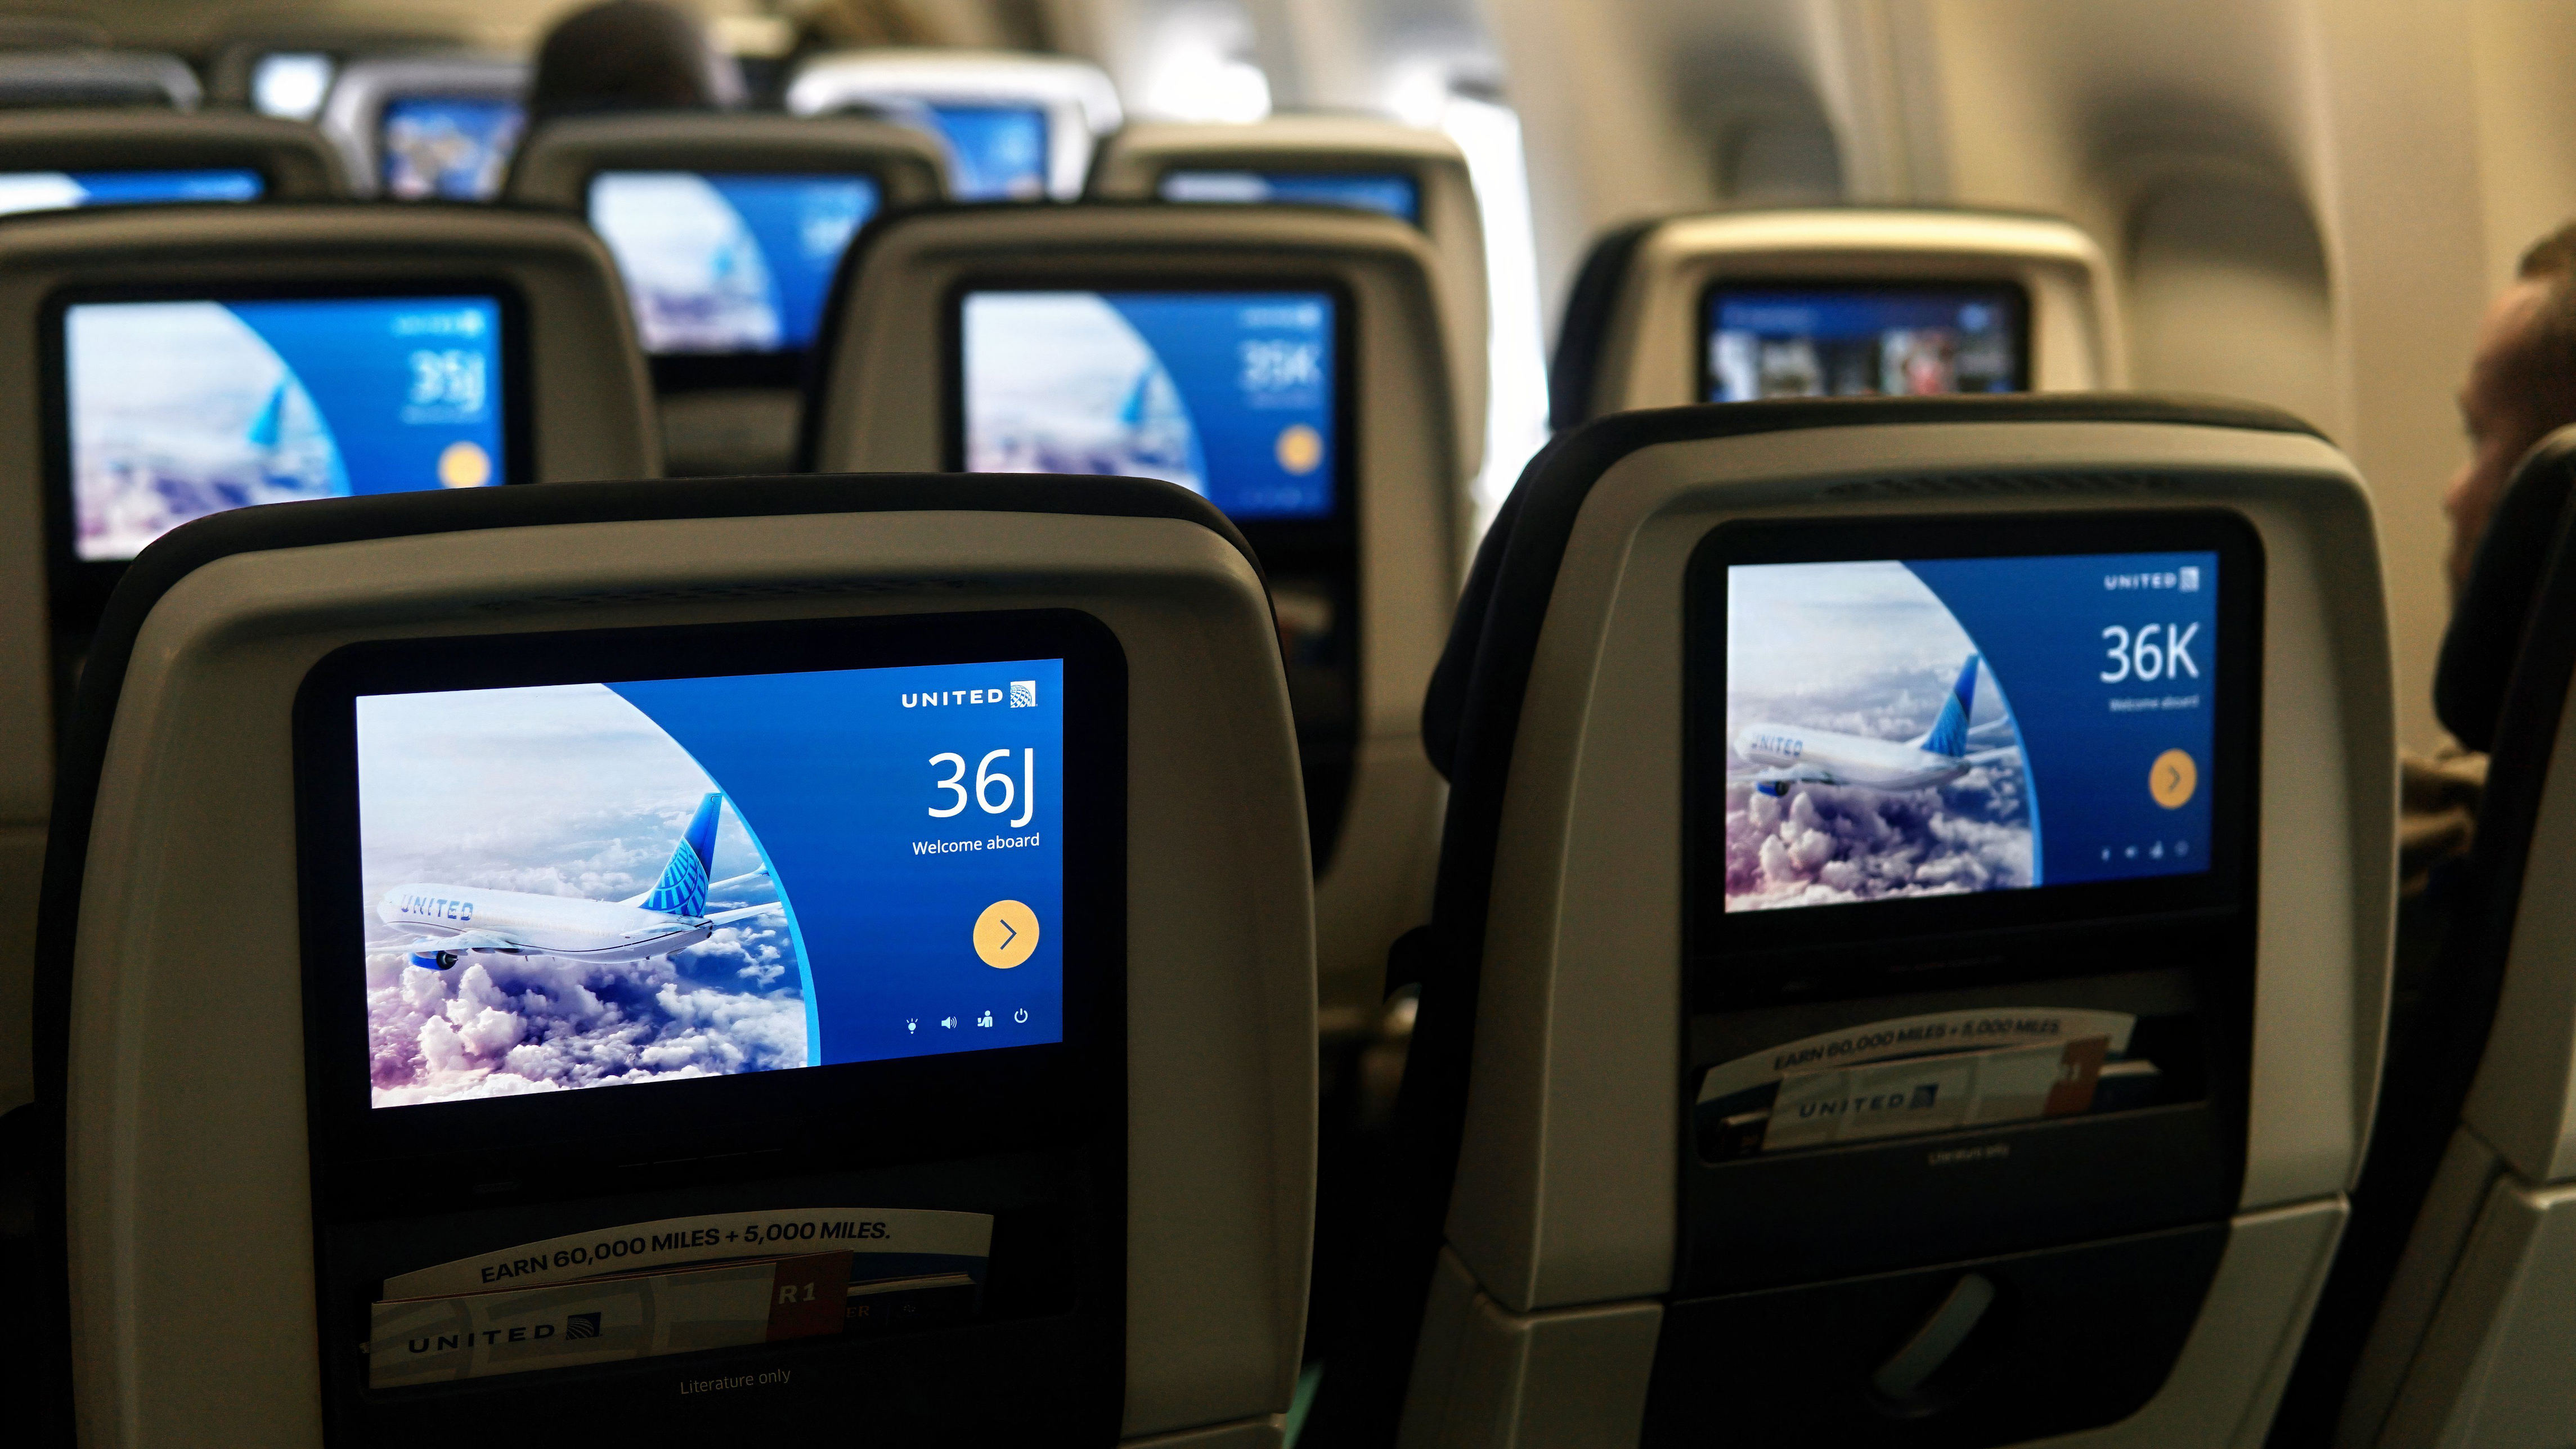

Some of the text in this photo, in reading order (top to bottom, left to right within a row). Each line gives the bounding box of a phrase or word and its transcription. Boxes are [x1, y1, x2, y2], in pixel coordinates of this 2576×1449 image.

[2104, 572, 2176, 590] UNITED
[2101, 622, 2199, 683] 36K
[901, 689, 1003, 708] UNITED
[928, 748, 1034, 828] 36J
[912, 832, 1040, 855] Welcome aboard
[400, 894, 474, 921] UNITED
[1799, 1092, 1904, 1119] UNITED
[481, 1222, 891, 1284] EARN 60,000 MILES + 5,000 MILES.
[408, 1324, 556, 1354] UNITED
[680, 1368, 791, 1396] Literature only
